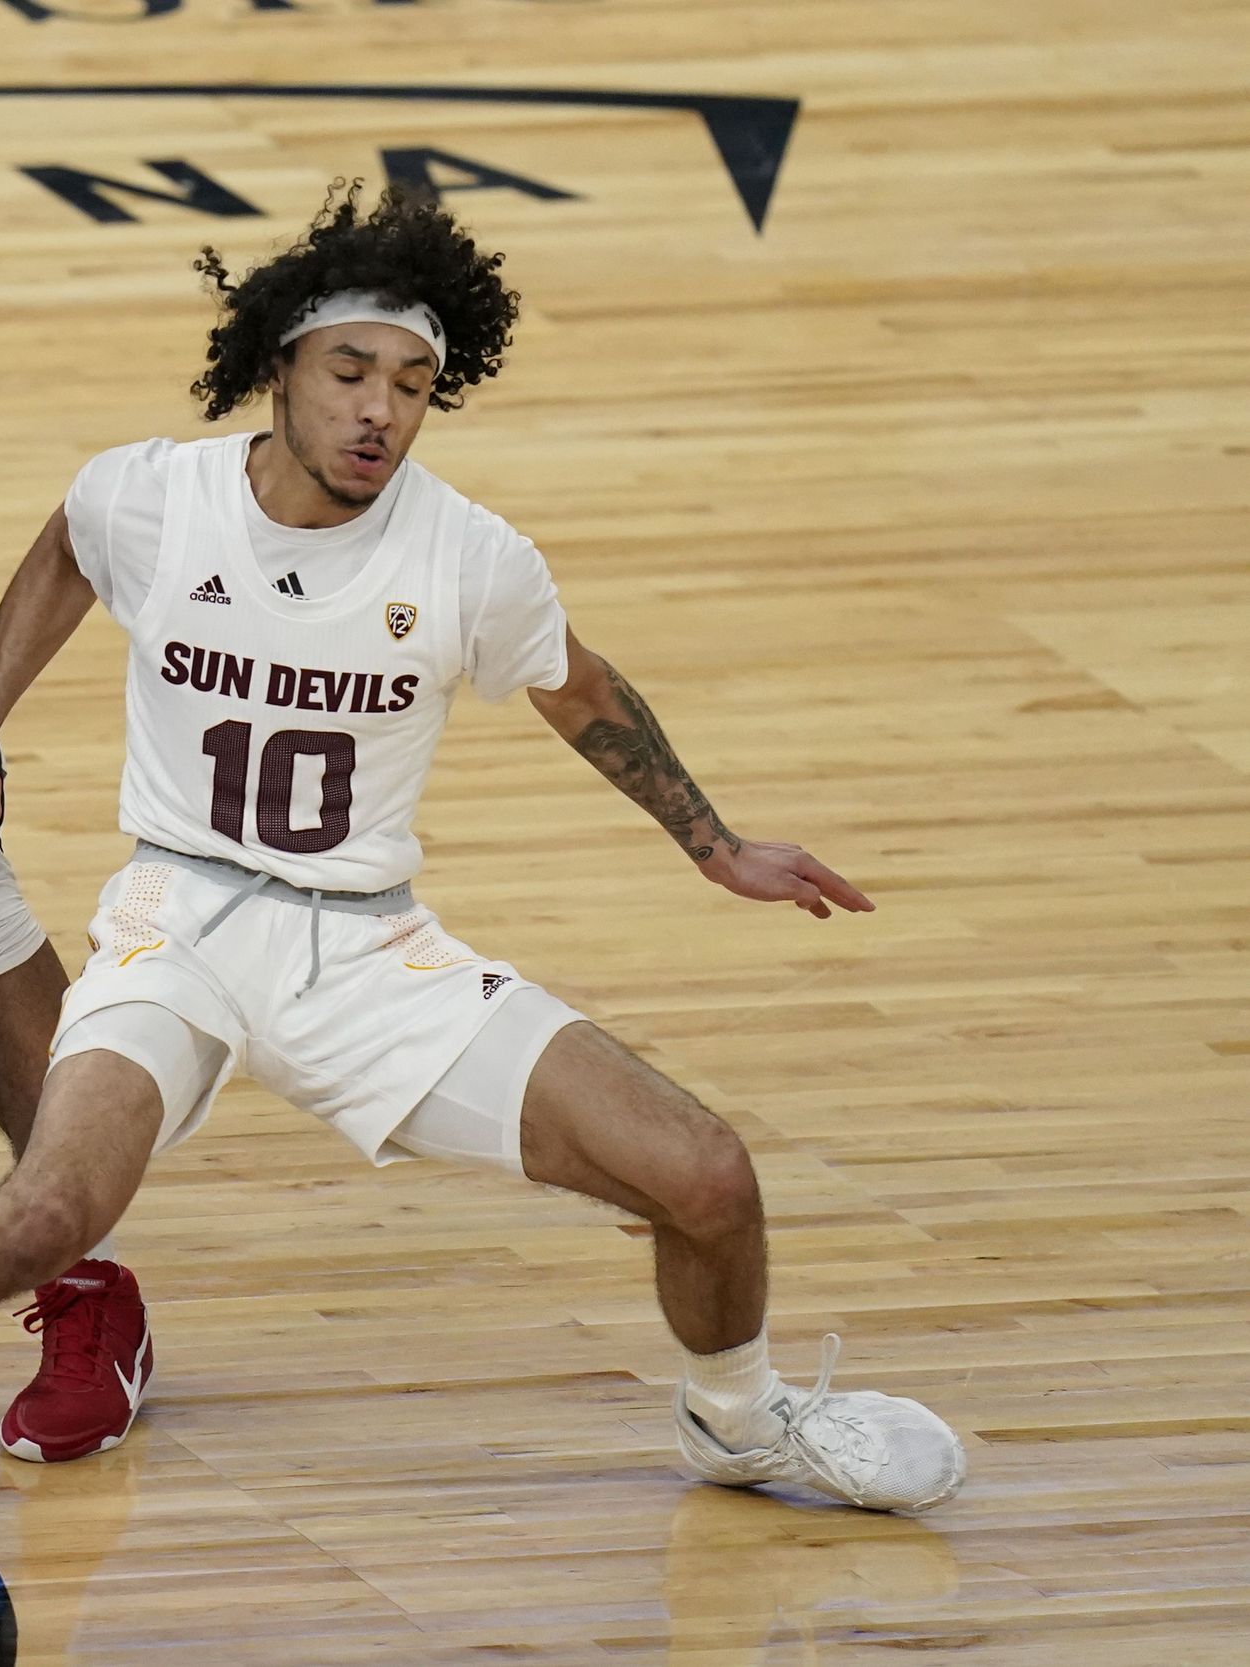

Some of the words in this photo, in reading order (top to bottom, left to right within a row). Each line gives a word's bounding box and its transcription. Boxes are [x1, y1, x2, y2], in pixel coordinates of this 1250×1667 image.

[190, 590, 232, 605] adidas
[392, 619, 408, 634] 12
[160, 641, 255, 700] SUN
[265, 662, 420, 713] DEVILS
[202, 719, 356, 854] 10
